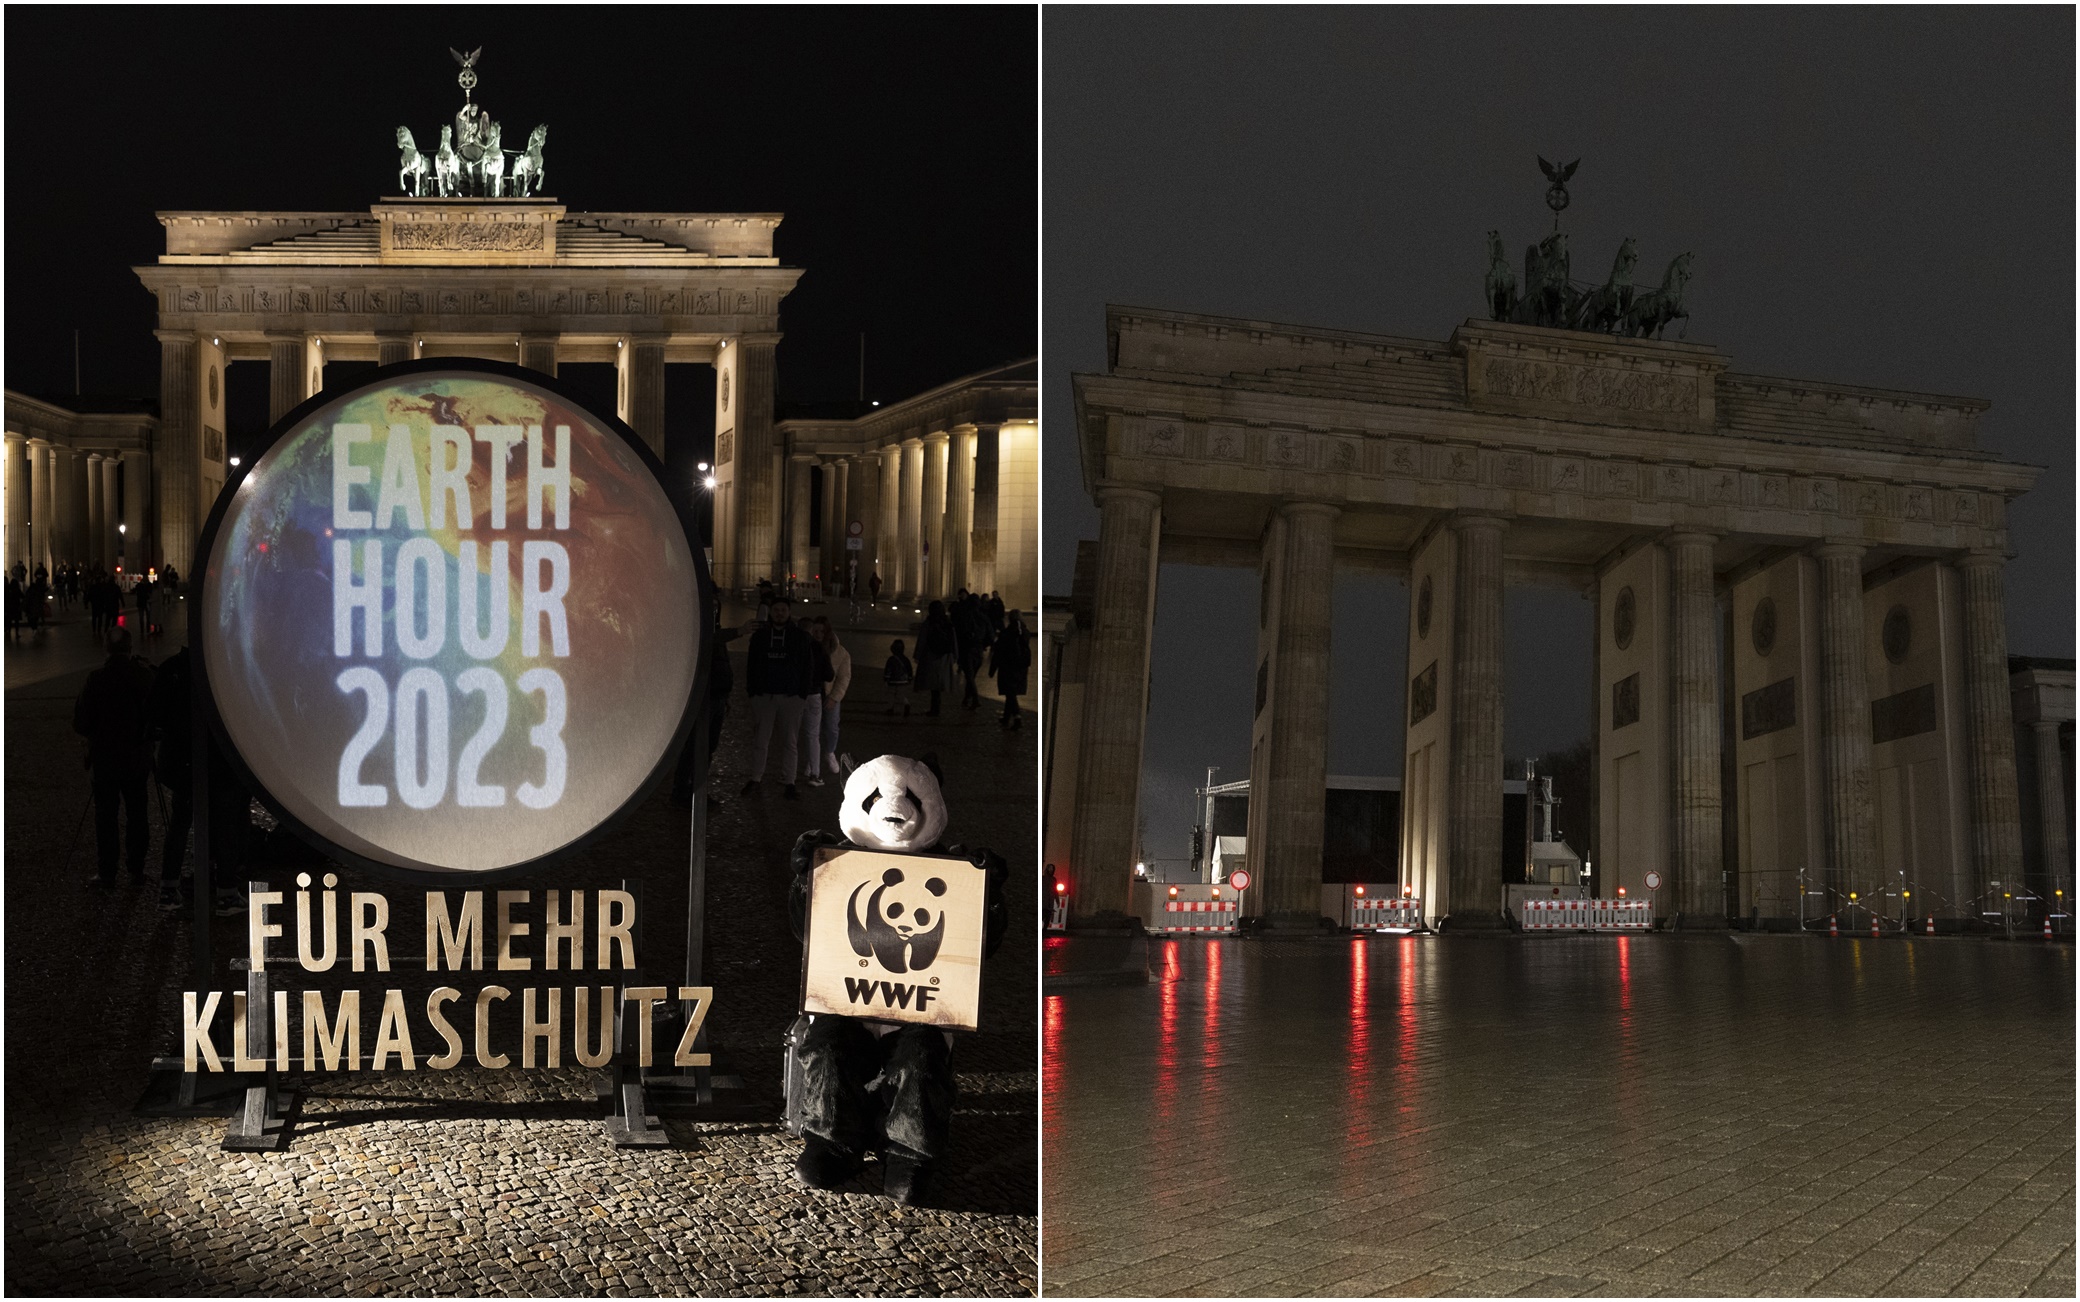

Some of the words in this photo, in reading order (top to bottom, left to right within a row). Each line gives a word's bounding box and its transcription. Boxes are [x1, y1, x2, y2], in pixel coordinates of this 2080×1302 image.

[332, 423, 571, 530] EARTH
[332, 538, 571, 660] HOUR
[336, 667, 568, 809] 2023
[250, 873, 391, 973] FÜR
[426, 889, 637, 972] MEHR
[183, 985, 714, 1073] KLIMASCHUTZ
[844, 976, 940, 1012] WWF
